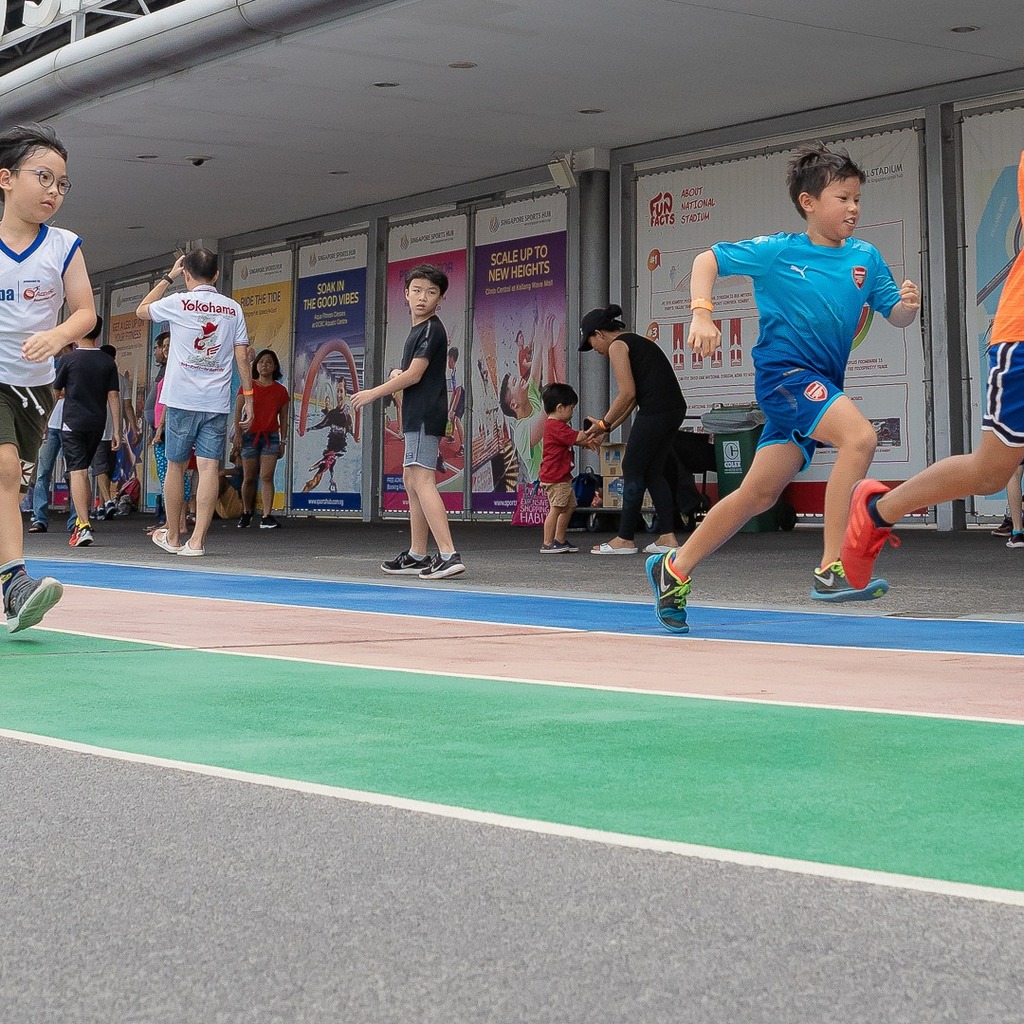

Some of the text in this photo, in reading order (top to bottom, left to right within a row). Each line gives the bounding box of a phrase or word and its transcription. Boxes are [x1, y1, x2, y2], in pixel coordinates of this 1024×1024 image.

[871, 164, 903, 177] STADIUM
[681, 186, 703, 198] ABOUT
[650, 192, 673, 216] FUN
[681, 198, 716, 210] NATIONAL
[500, 216, 524, 227] SINGAPORE
[524, 212, 541, 221] SPORTS
[651, 213, 675, 227] FACTS
[681, 212, 710, 224] STADIUM
[491, 244, 548, 266] SCALE UP TO
[488, 260, 550, 282] NEW HEIGHTS
[317, 280, 345, 295] SOAK IN
[240, 291, 281, 307] RIDE THE TIDE
[303, 291, 359, 311] THE GOOD VIBES
[181, 299, 236, 316] Yokohama
